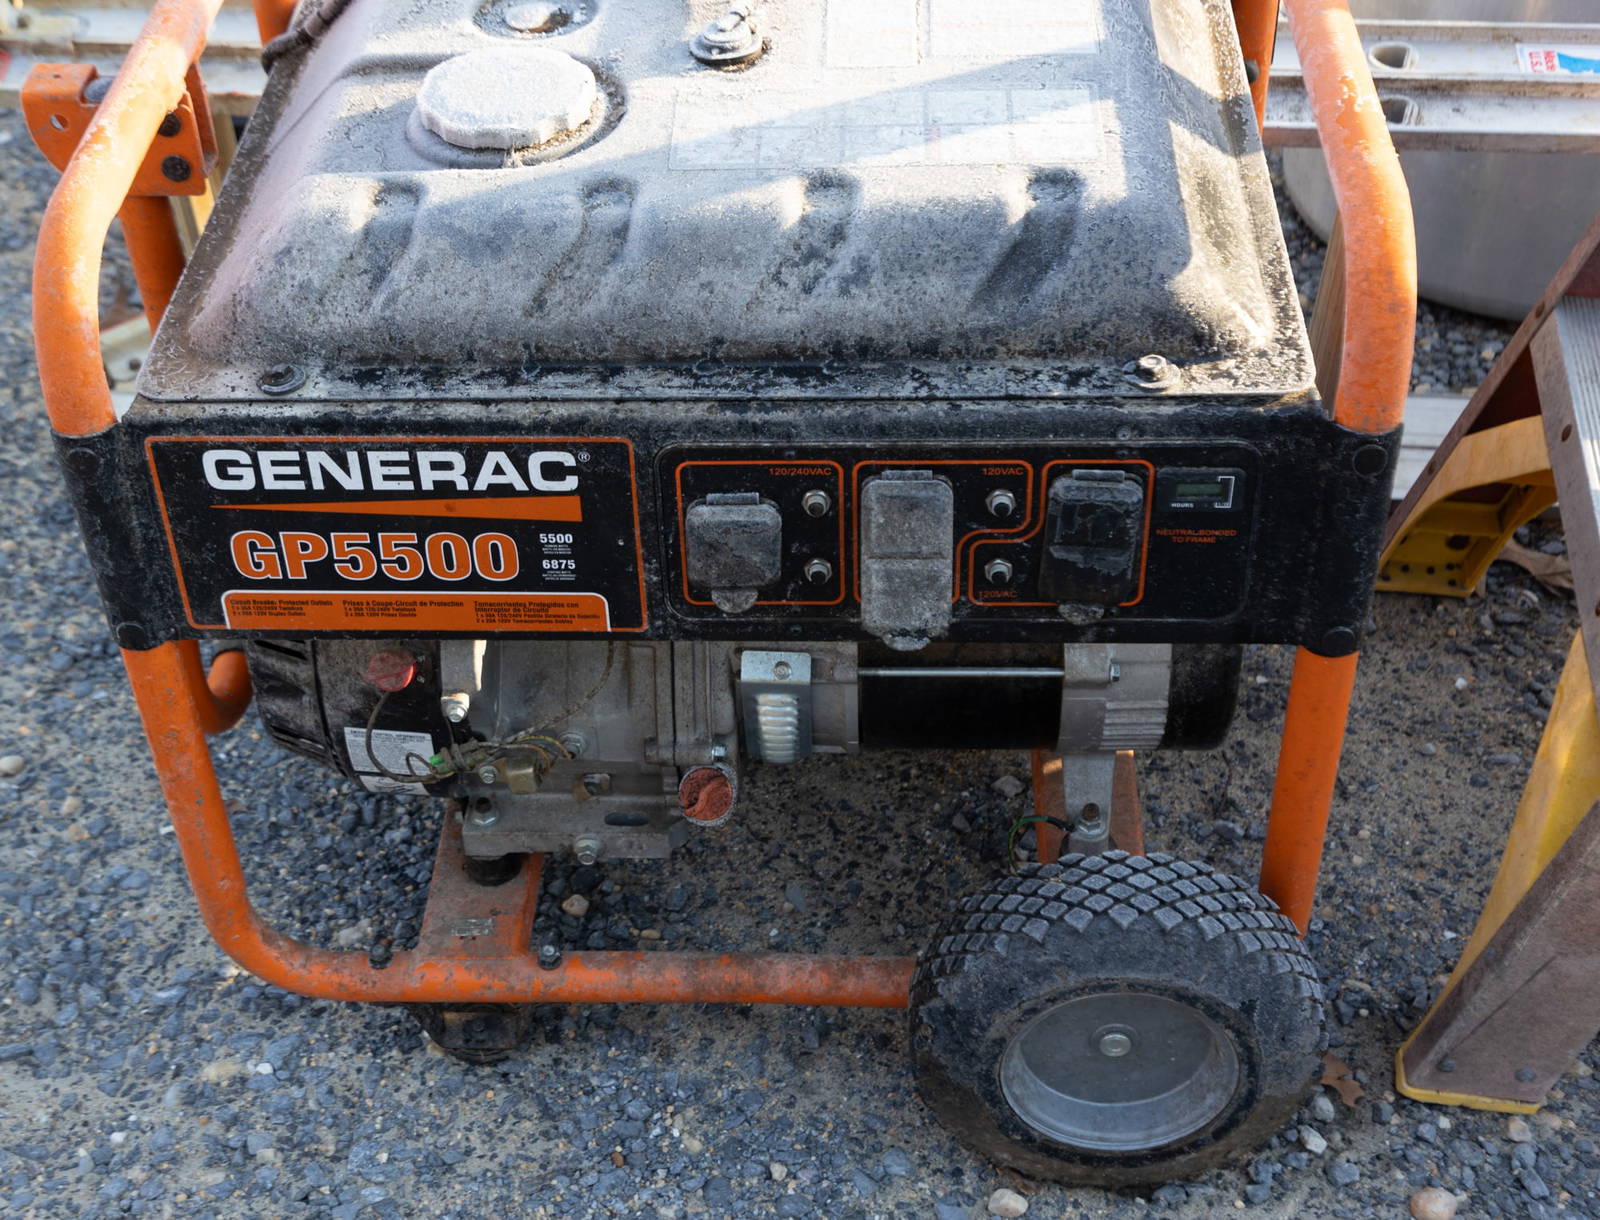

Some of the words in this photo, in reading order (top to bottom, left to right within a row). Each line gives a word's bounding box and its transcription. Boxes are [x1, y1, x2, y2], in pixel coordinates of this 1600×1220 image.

[769, 467, 832, 476] 120/240VAC
[981, 467, 1024, 476] 120VAC
[539, 533, 573, 544] 5500
[230, 529, 520, 582] GP5500
[542, 559, 576, 570] 6875
[980, 590, 1017, 599] 120VAC
